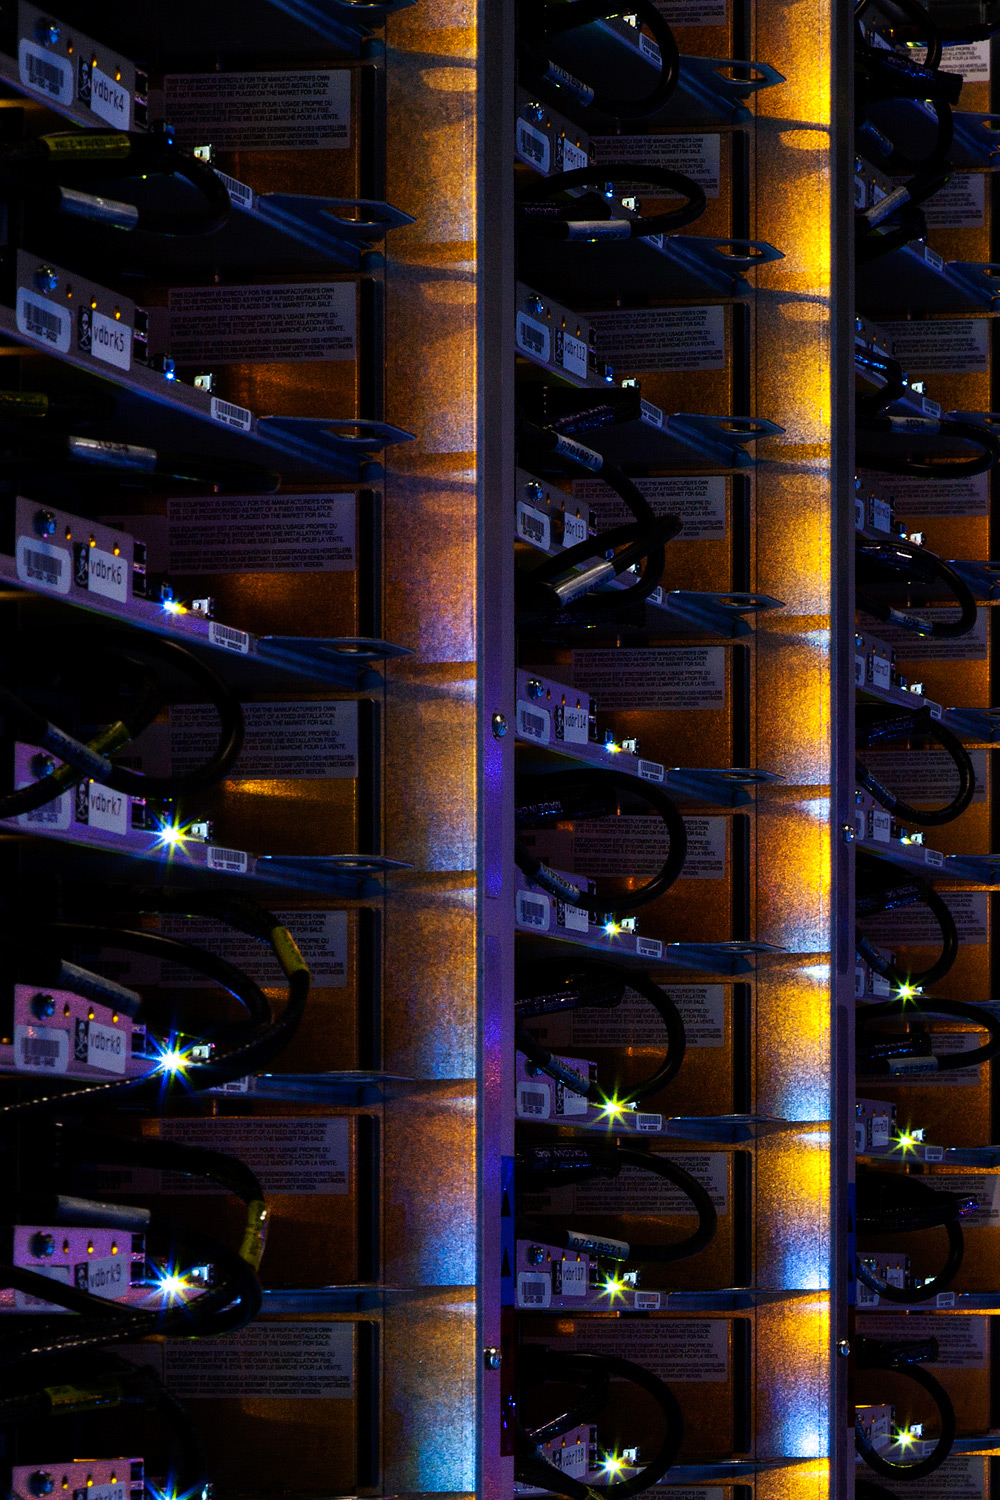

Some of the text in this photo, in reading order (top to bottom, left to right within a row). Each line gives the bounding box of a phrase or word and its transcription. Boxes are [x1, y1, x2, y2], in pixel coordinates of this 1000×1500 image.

[92, 78, 124, 112] vdbrk4
[93, 325, 124, 352] vdbrk5
[90, 558, 123, 586] vdbrk6
[90, 793, 122, 816] vdbrk7
[89, 1031, 121, 1054] vdbrk8
[88, 1263, 121, 1290] vdbrk9
